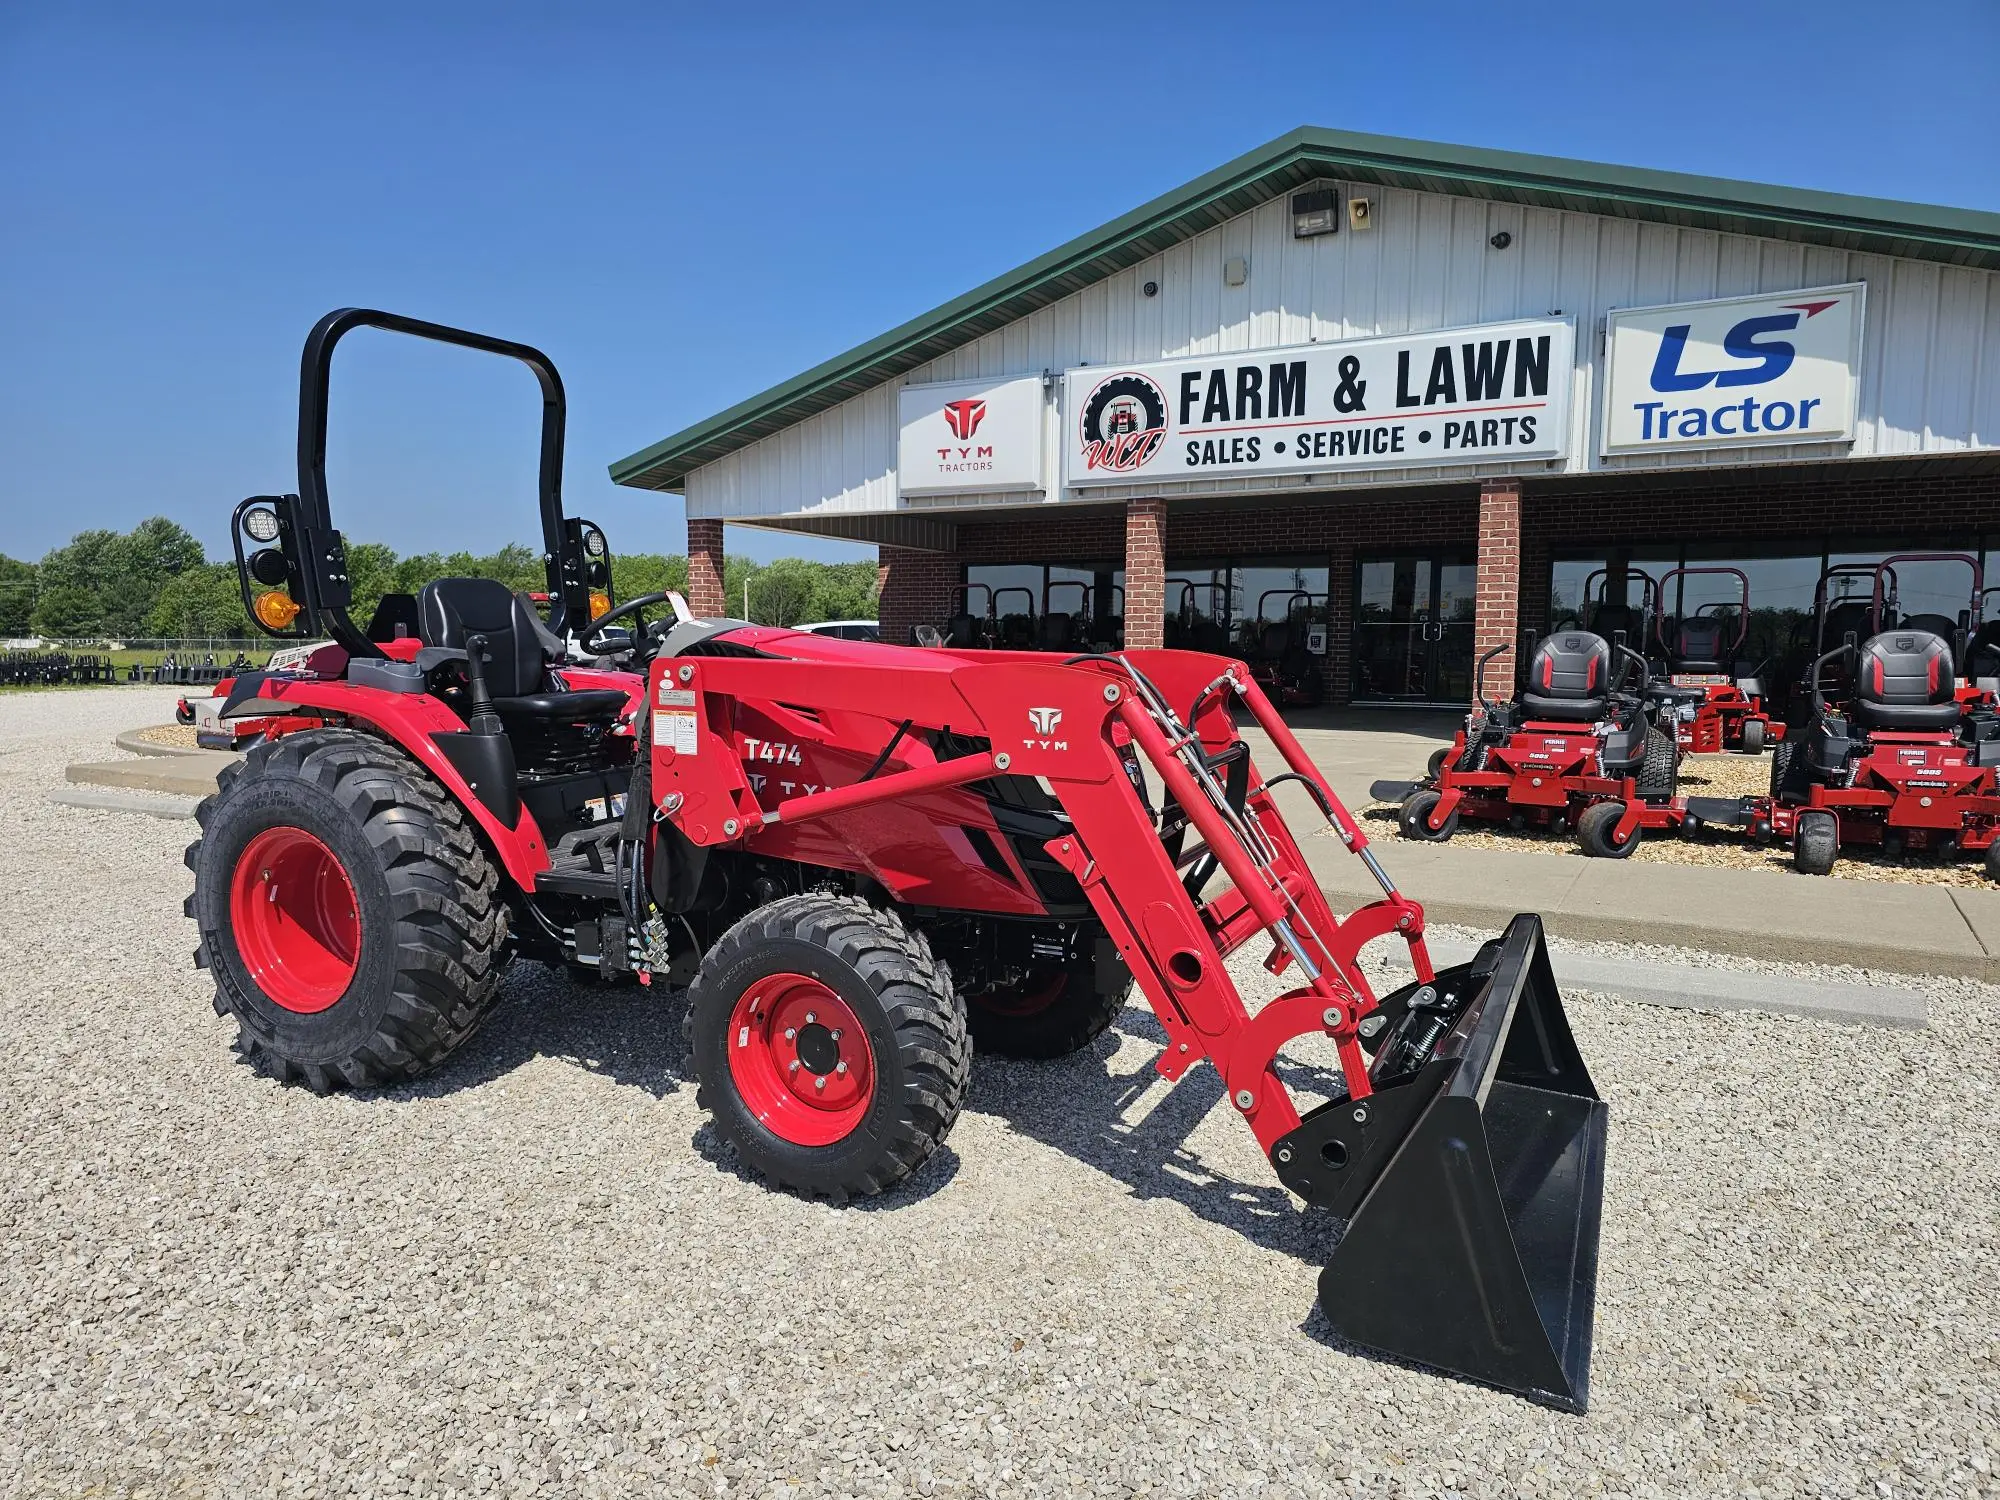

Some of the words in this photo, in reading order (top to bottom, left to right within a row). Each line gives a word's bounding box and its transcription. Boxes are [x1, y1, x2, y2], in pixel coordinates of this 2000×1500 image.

[1650, 312, 1801, 393] LS
[1179, 360, 1307, 425] FARM
[1333, 355, 1367, 414] &
[1396, 335, 1551, 408] LAWN
[1634, 396, 1821, 440] Tractor
[937, 446, 993, 460] TYM
[1081, 428, 1167, 471] WCT
[1186, 436, 1261, 467] SALES
[1296, 426, 1405, 460] SERVICE
[1444, 415, 1538, 450] PARTS
[938, 461, 993, 472] TRACTORS
[744, 738, 802, 766] T474
[1023, 739, 1068, 751] TYM
[780, 781, 840, 797] TY
